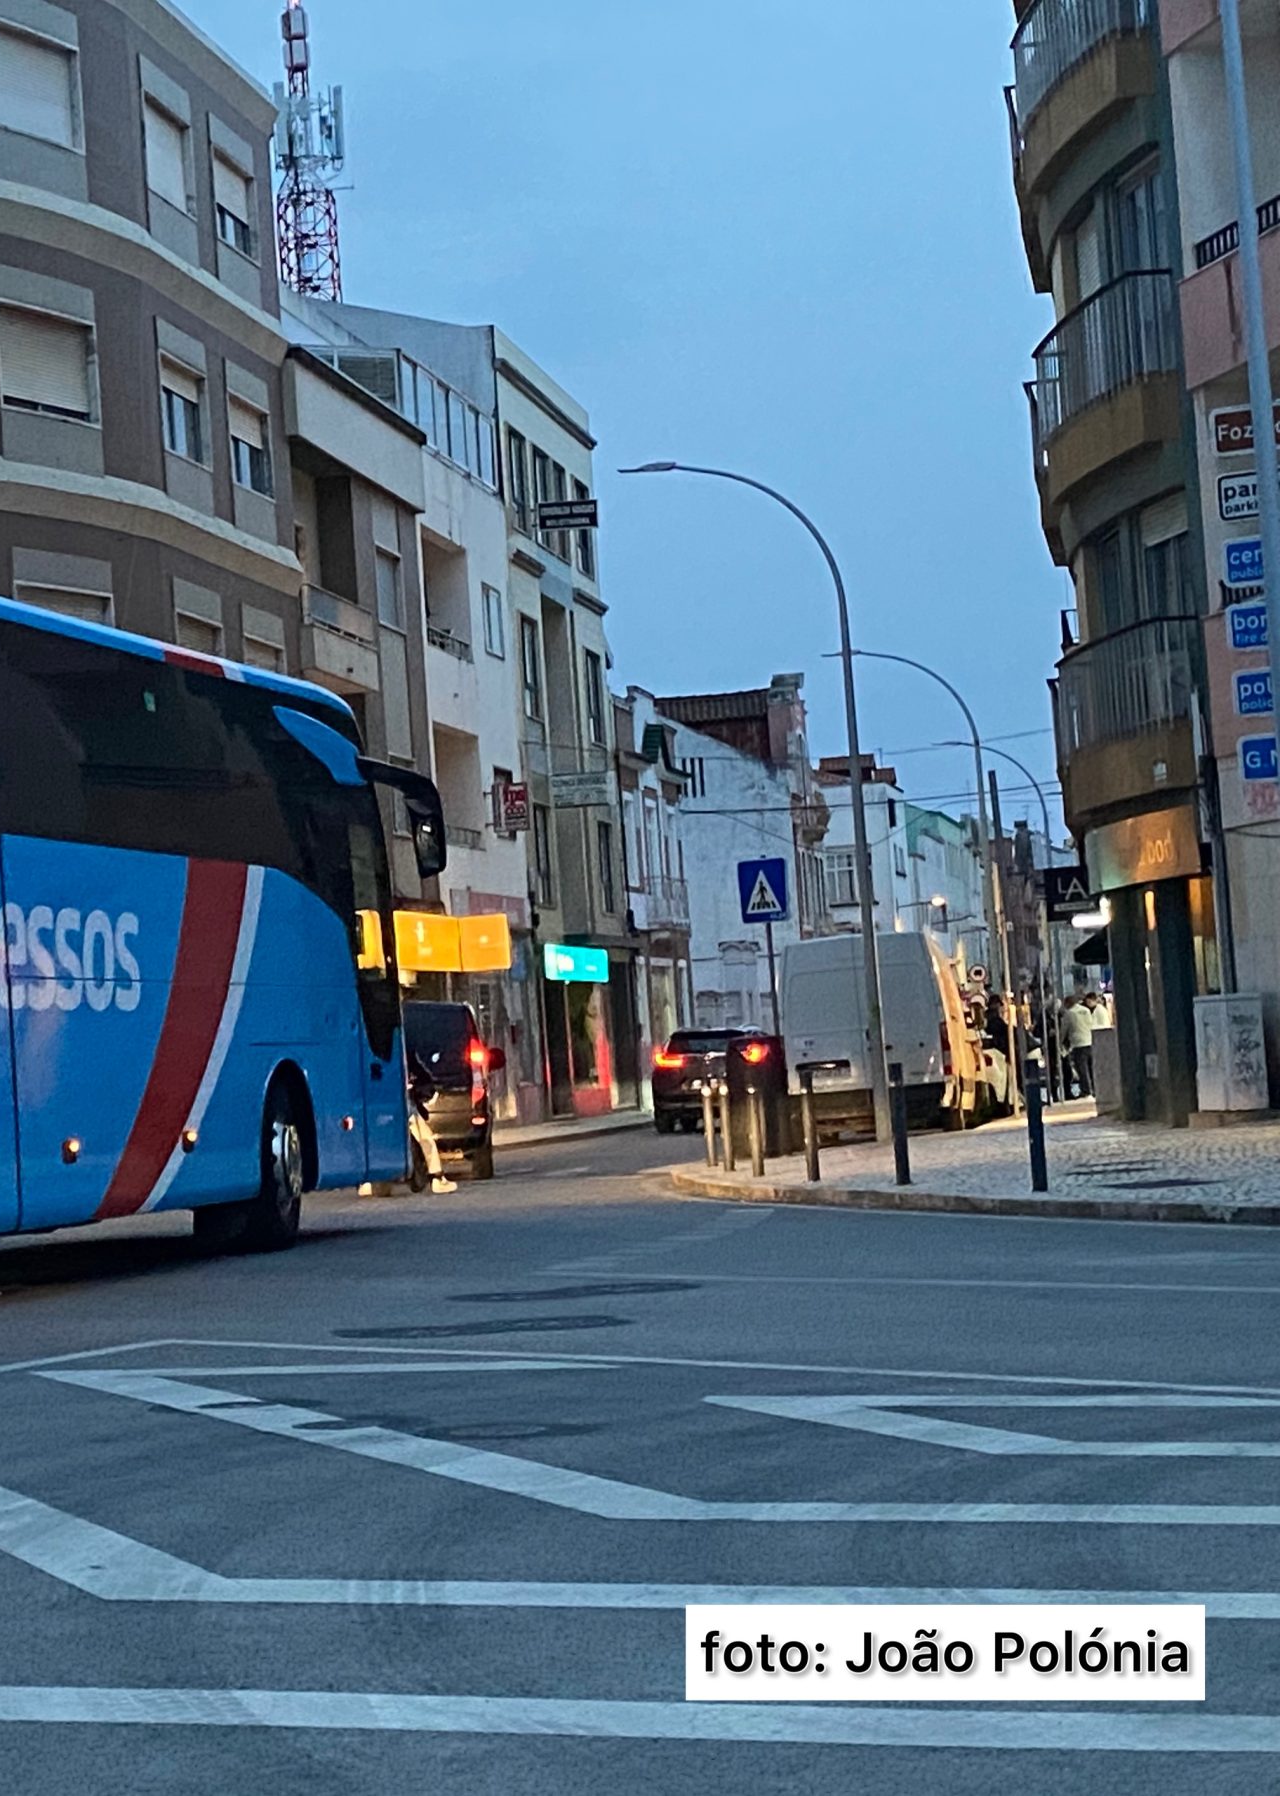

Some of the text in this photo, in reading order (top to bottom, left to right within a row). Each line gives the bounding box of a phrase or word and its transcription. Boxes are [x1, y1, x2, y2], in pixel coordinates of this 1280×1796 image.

[1223, 483, 1257, 503] par
[1225, 500, 1258, 515] parki
[1239, 677, 1273, 700] pol
